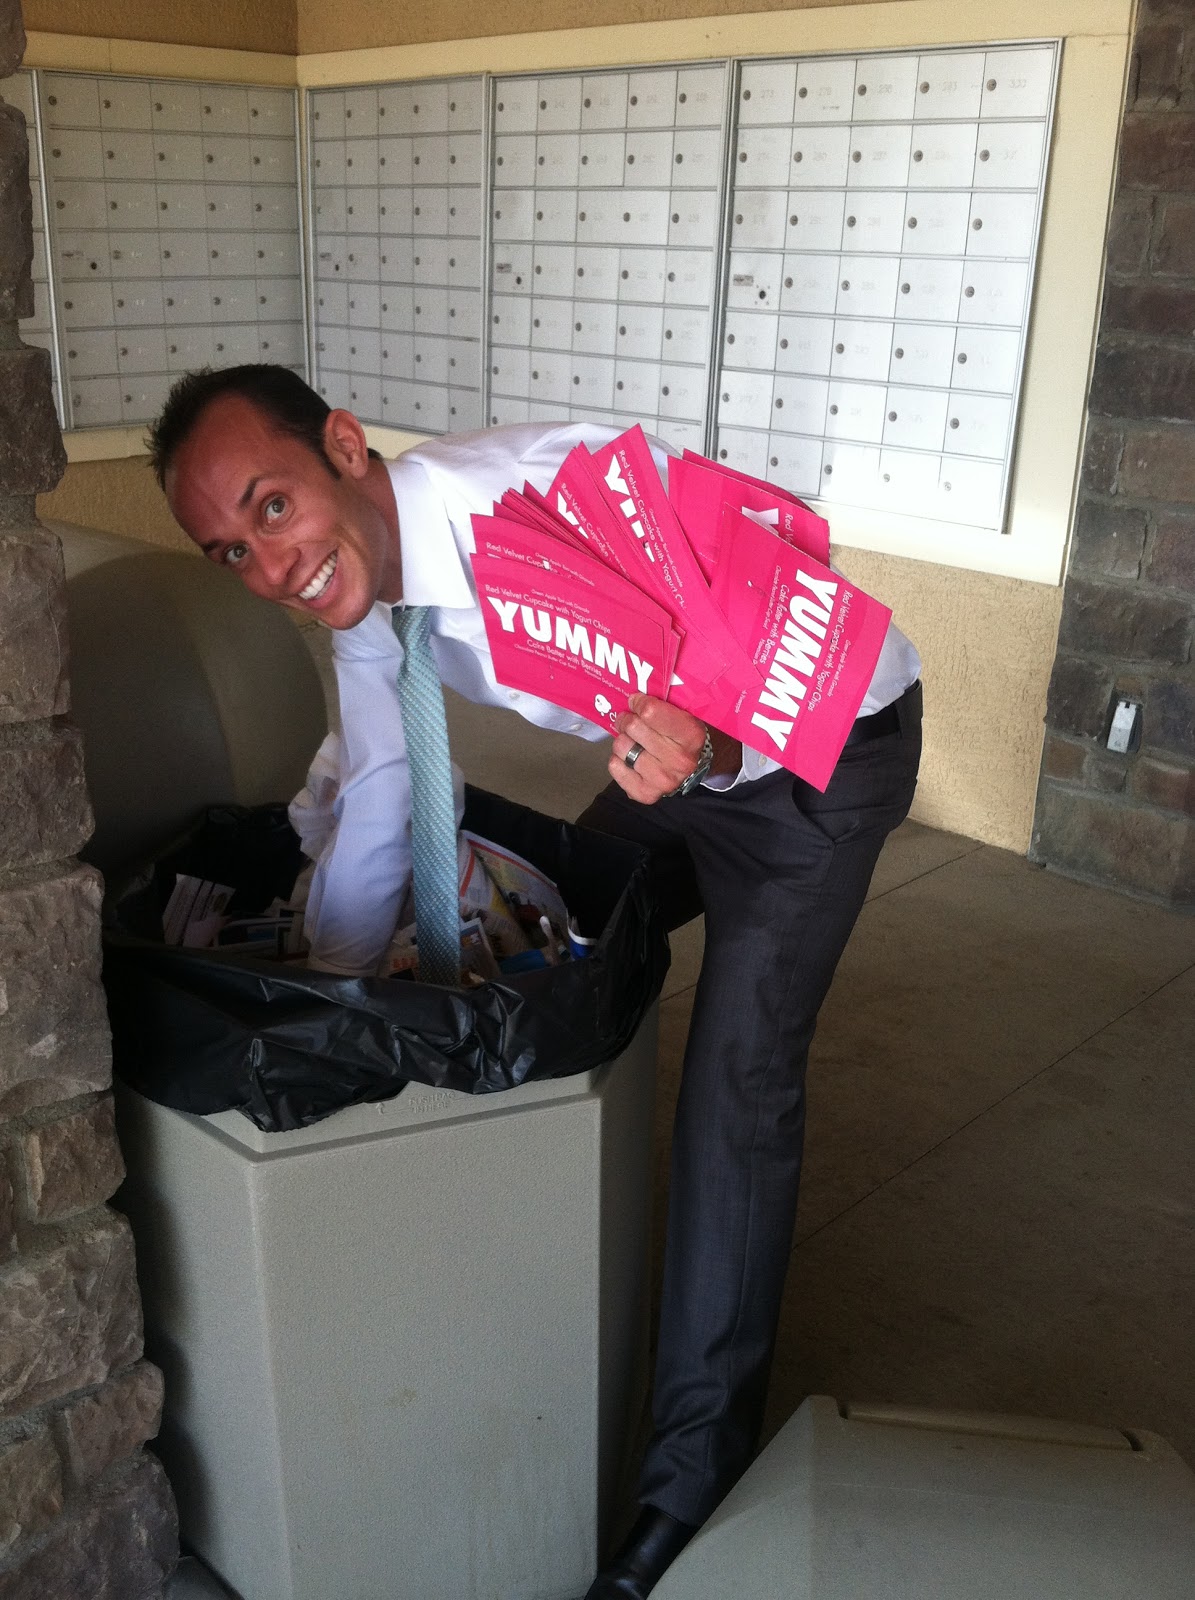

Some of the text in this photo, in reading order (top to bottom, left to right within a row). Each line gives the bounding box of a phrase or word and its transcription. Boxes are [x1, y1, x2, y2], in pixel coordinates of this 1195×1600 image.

[561, 483, 572, 500] Red
[572, 499, 587, 523] Velvet
[619, 450, 678, 592] Red Velvet Cupcake with Yogurt
[785, 513, 794, 532] Red
[486, 542, 501, 552] Red
[503, 547, 524, 560] Velvet
[485, 584, 611, 634] Red Velvet Cupcake with Yogurt Chips
[780, 584, 790, 602] Cake
[487, 596, 654, 694] YUMMY
[770, 622, 779, 638] with
[566, 653, 580, 665] with
[581, 660, 602, 677] Berries
[750, 568, 838, 752] YUMMY
[760, 639, 776, 664] Berries
[808, 590, 853, 712] Red Velvet Cupcake with Yogurt Chips
